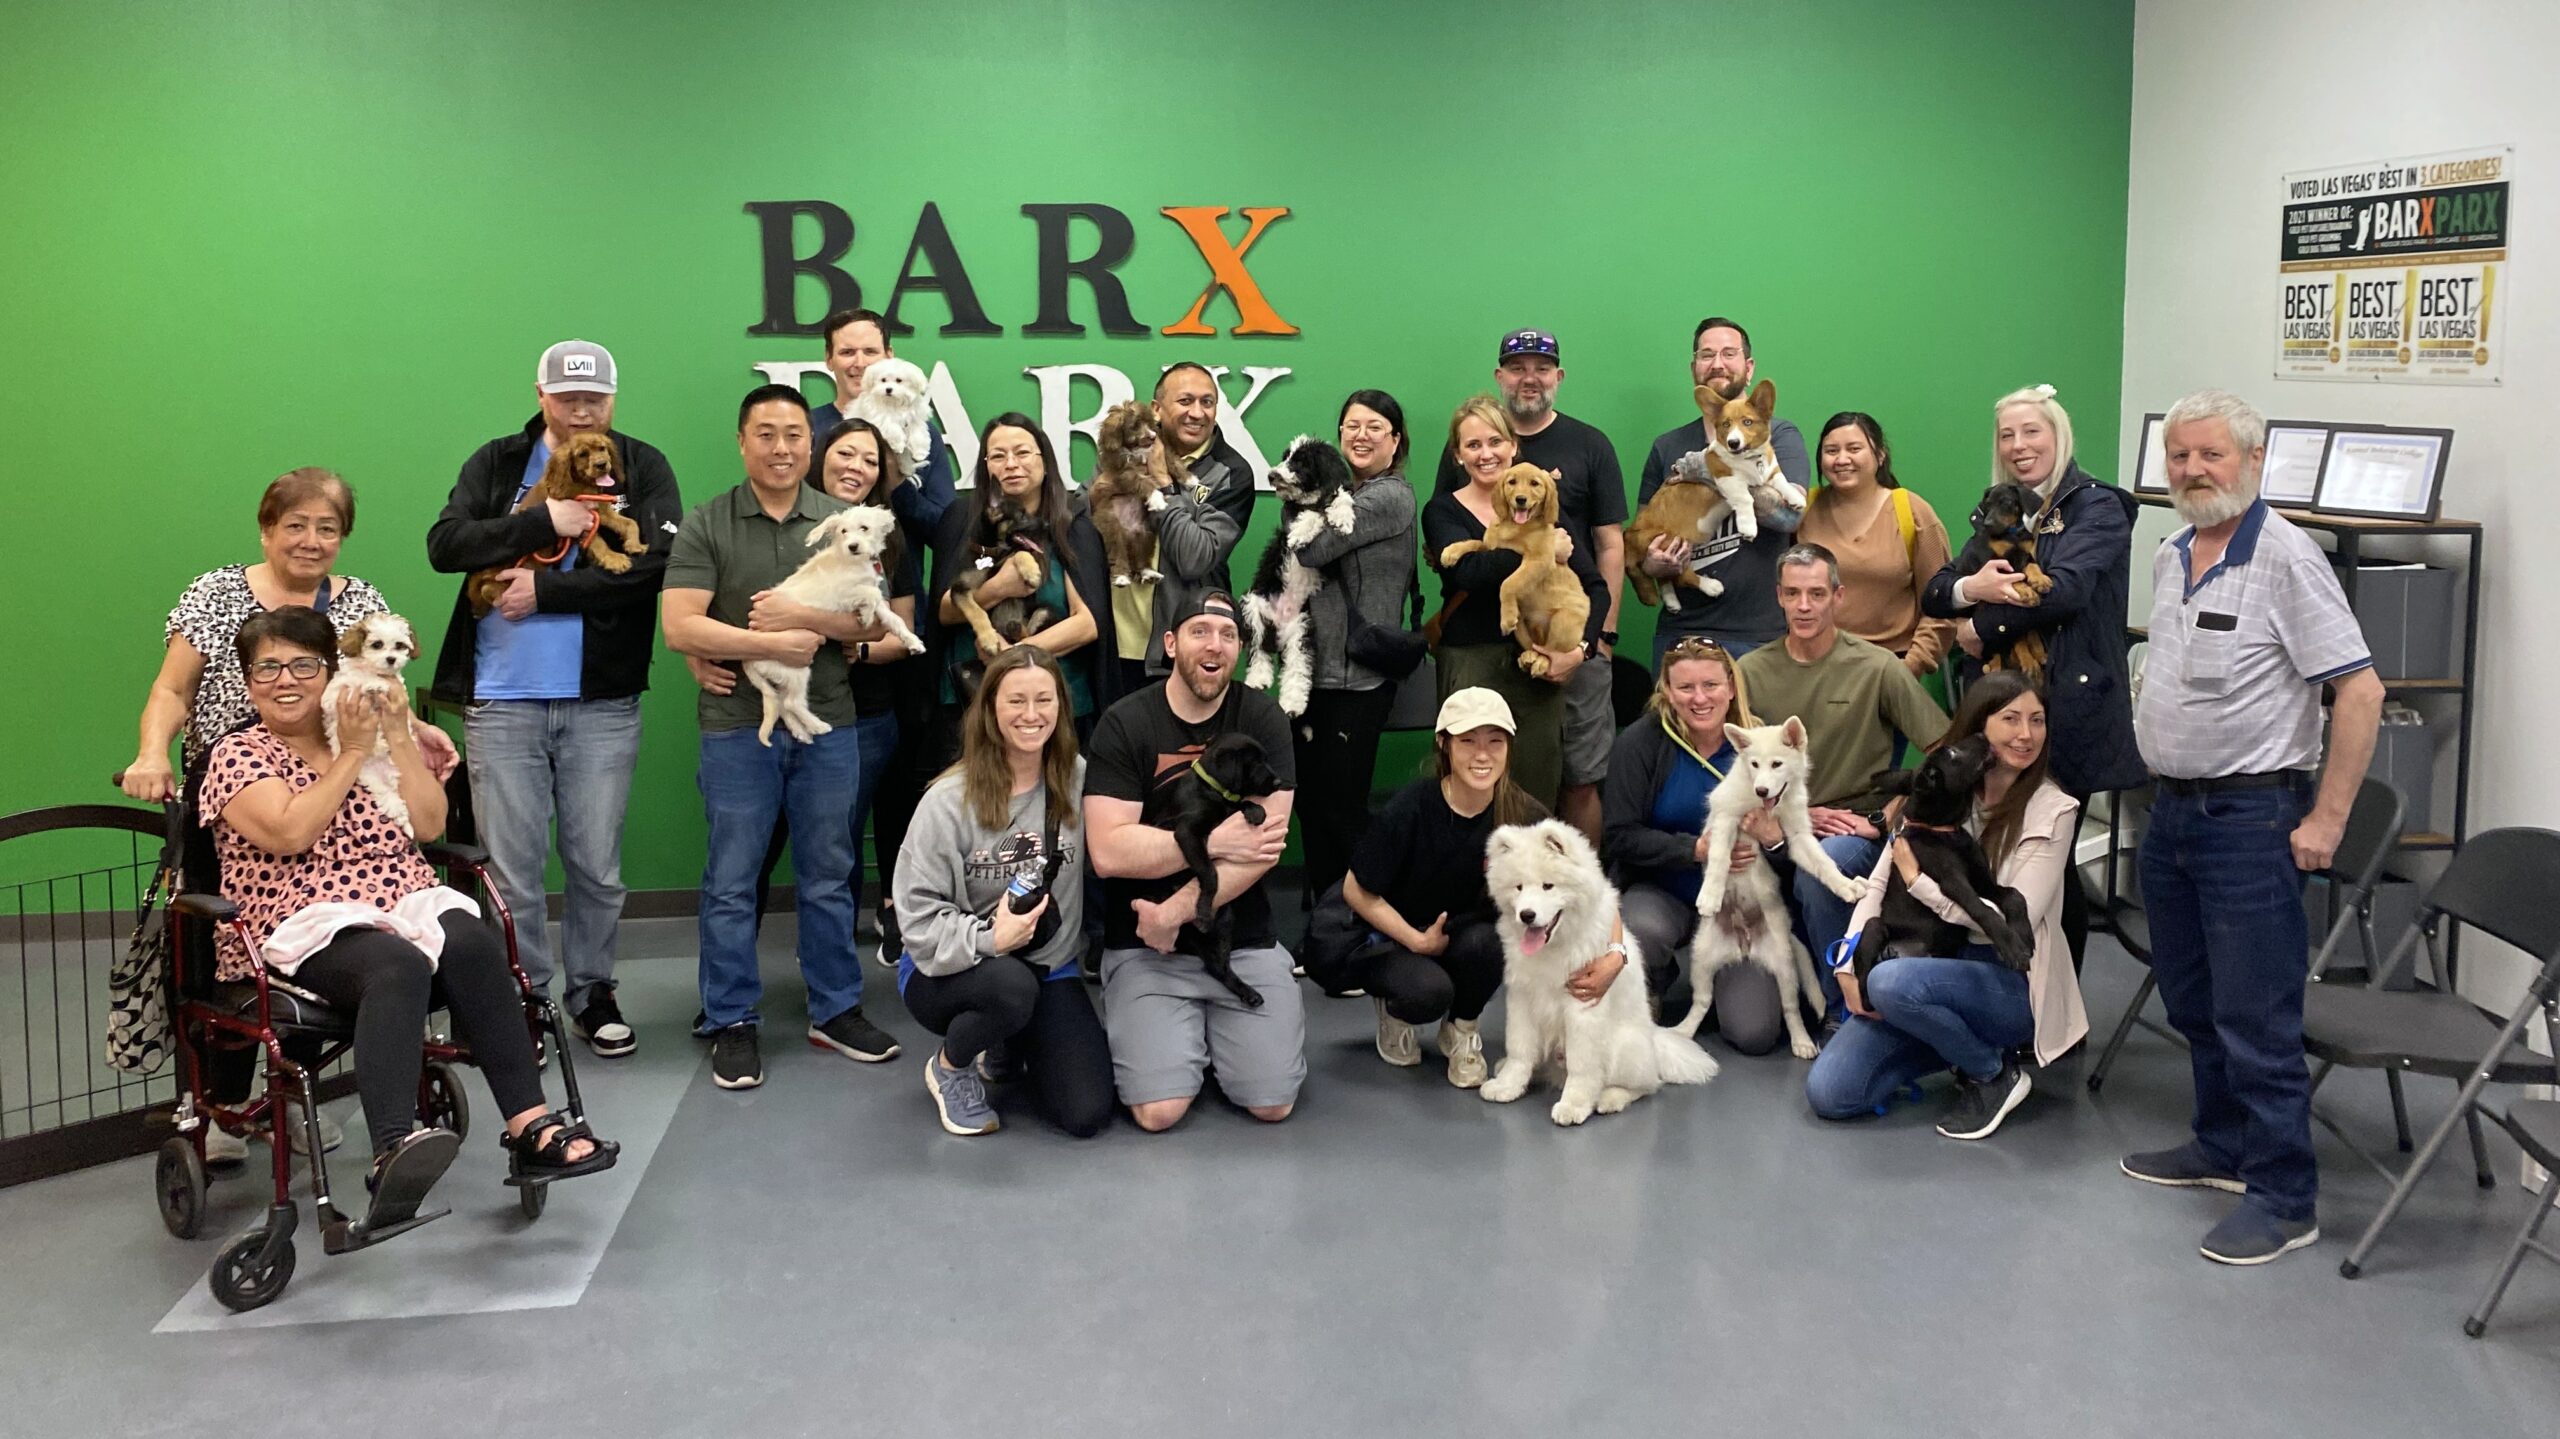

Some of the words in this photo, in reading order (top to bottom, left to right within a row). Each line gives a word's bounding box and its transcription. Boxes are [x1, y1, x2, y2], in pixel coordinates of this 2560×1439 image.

[2290, 179, 2319, 200] VOTED
[2321, 176, 2339, 197] LAS
[2378, 168, 2403, 190] BEST
[2406, 166, 2418, 187] IN
[2420, 165, 2428, 185] 3
[744, 199, 1300, 335] BARX
[2285, 284, 2329, 320] BEST
[2349, 281, 2398, 318] BEST
[2420, 277, 2473, 317] BEST
[2284, 322, 2300, 339] LAS
[2302, 322, 2331, 339] VEGAS
[2348, 321, 2366, 339] LAS
[2368, 321, 2400, 339] VEGAS
[2419, 320, 2438, 339] LAS
[2441, 320, 2477, 339] VEGAS
